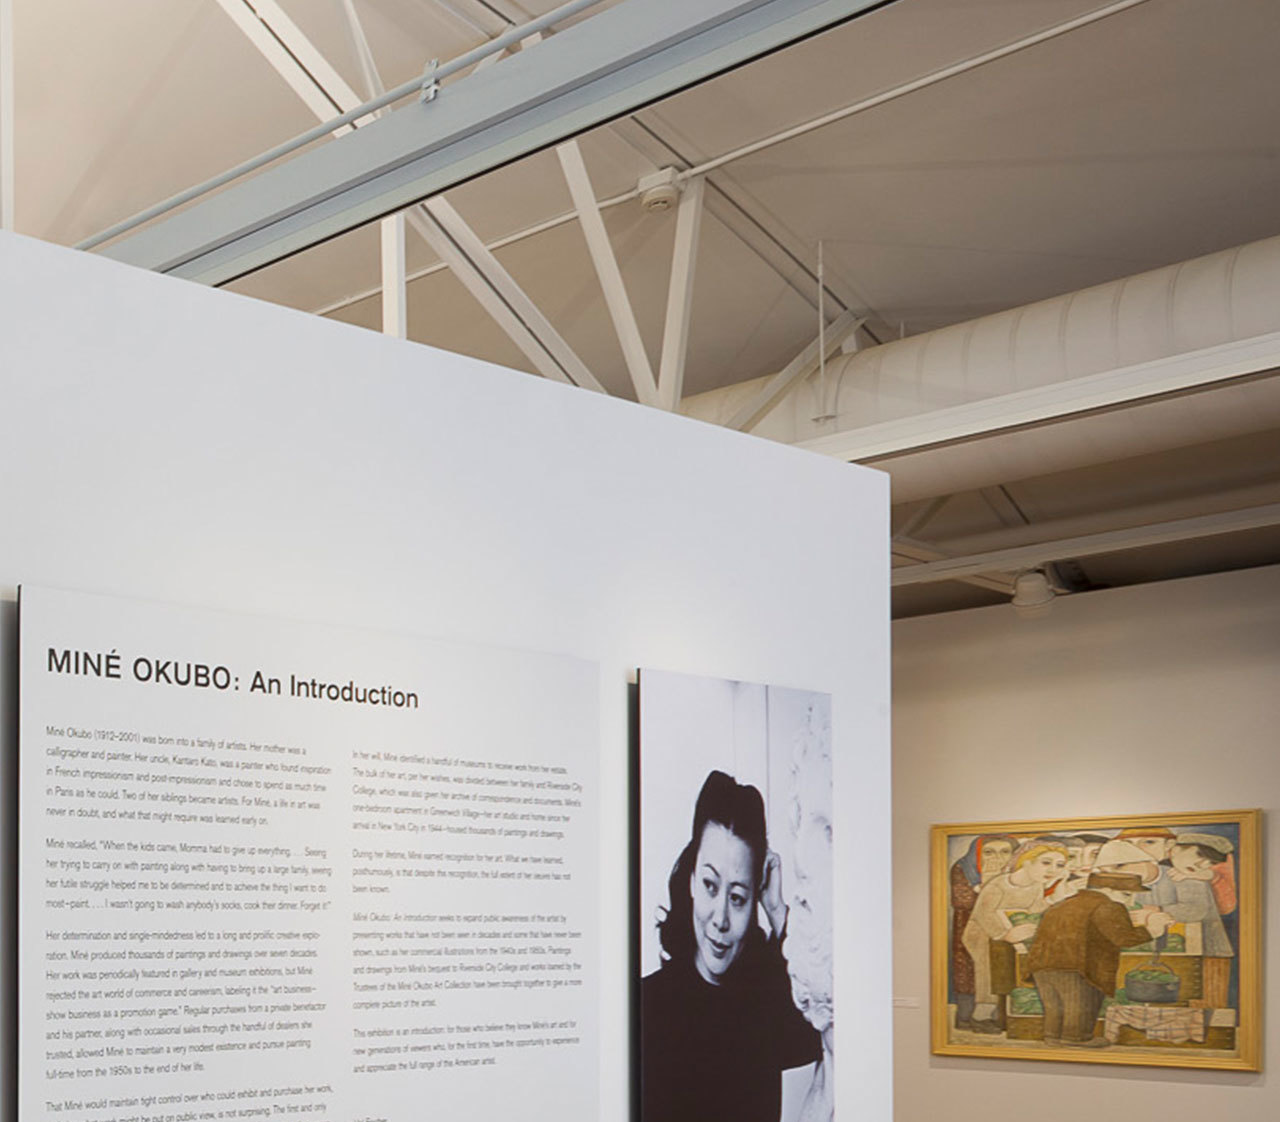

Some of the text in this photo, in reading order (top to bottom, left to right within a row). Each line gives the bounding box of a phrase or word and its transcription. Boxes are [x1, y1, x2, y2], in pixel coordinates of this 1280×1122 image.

[47, 647, 419, 708] MINÉ OKUBO: An Introduction
[66, 726, 92, 738] Okubo
[46, 745, 89, 760] calligrapher
[90, 748, 105, 759] and
[133, 751, 147, 762] Her
[46, 765, 149, 783] in French impressionism and
[46, 785, 53, 796] in
[54, 785, 74, 797] Paris
[75, 789, 85, 797] as
[85, 787, 96, 798] he
[121, 789, 136, 800] Two
[137, 790, 145, 800] of
[46, 807, 67, 816] never
[67, 806, 75, 816] in
[101, 808, 116, 818] and
[117, 808, 135, 819] what
[136, 809, 151, 820] that
[125, 840, 138, 850] the
[139, 840, 154, 851] kids
[45, 858, 168, 873] her trying to carry on with painting
[45, 877, 58, 888] her
[59, 878, 78, 888] futile
[79, 878, 109, 891] struggle
[110, 879, 136, 891] helped
[134, 898, 155, 911] going
[45, 929, 193, 941] Her determination and single-mindedness
[90, 949, 126, 962] produced
[127, 949, 164, 959] thousands
[45, 969, 60, 980] Her
[61, 969, 80, 979] work
[81, 971, 97, 979] was
[98, 968, 139, 981] periodically
[45, 987, 172, 1002] rejected the art world of commerce
[45, 1009, 66, 1020] show
[67, 1008, 101, 1019] business
[102, 1010, 111, 1018] as
[119, 1006, 155, 1019] promotion
[45, 1029, 60, 1040] and
[61, 1028, 73, 1039] his
[104, 1026, 125, 1039] along
[126, 1026, 142, 1036] with
[75, 1046, 104, 1058] allowed
[125, 1045, 132, 1055] to
[133, 1044, 164, 1055] maintain
[45, 1067, 75, 1079] full-time
[76, 1066, 93, 1077] from
[94, 1065, 107, 1076] the
[108, 1064, 132, 1075] 1950s
[133, 1064, 141, 1074] to
[45, 1100, 63, 1112] That
[84, 1098, 107, 1109] would
[108, 1095, 139, 1107] maintain
